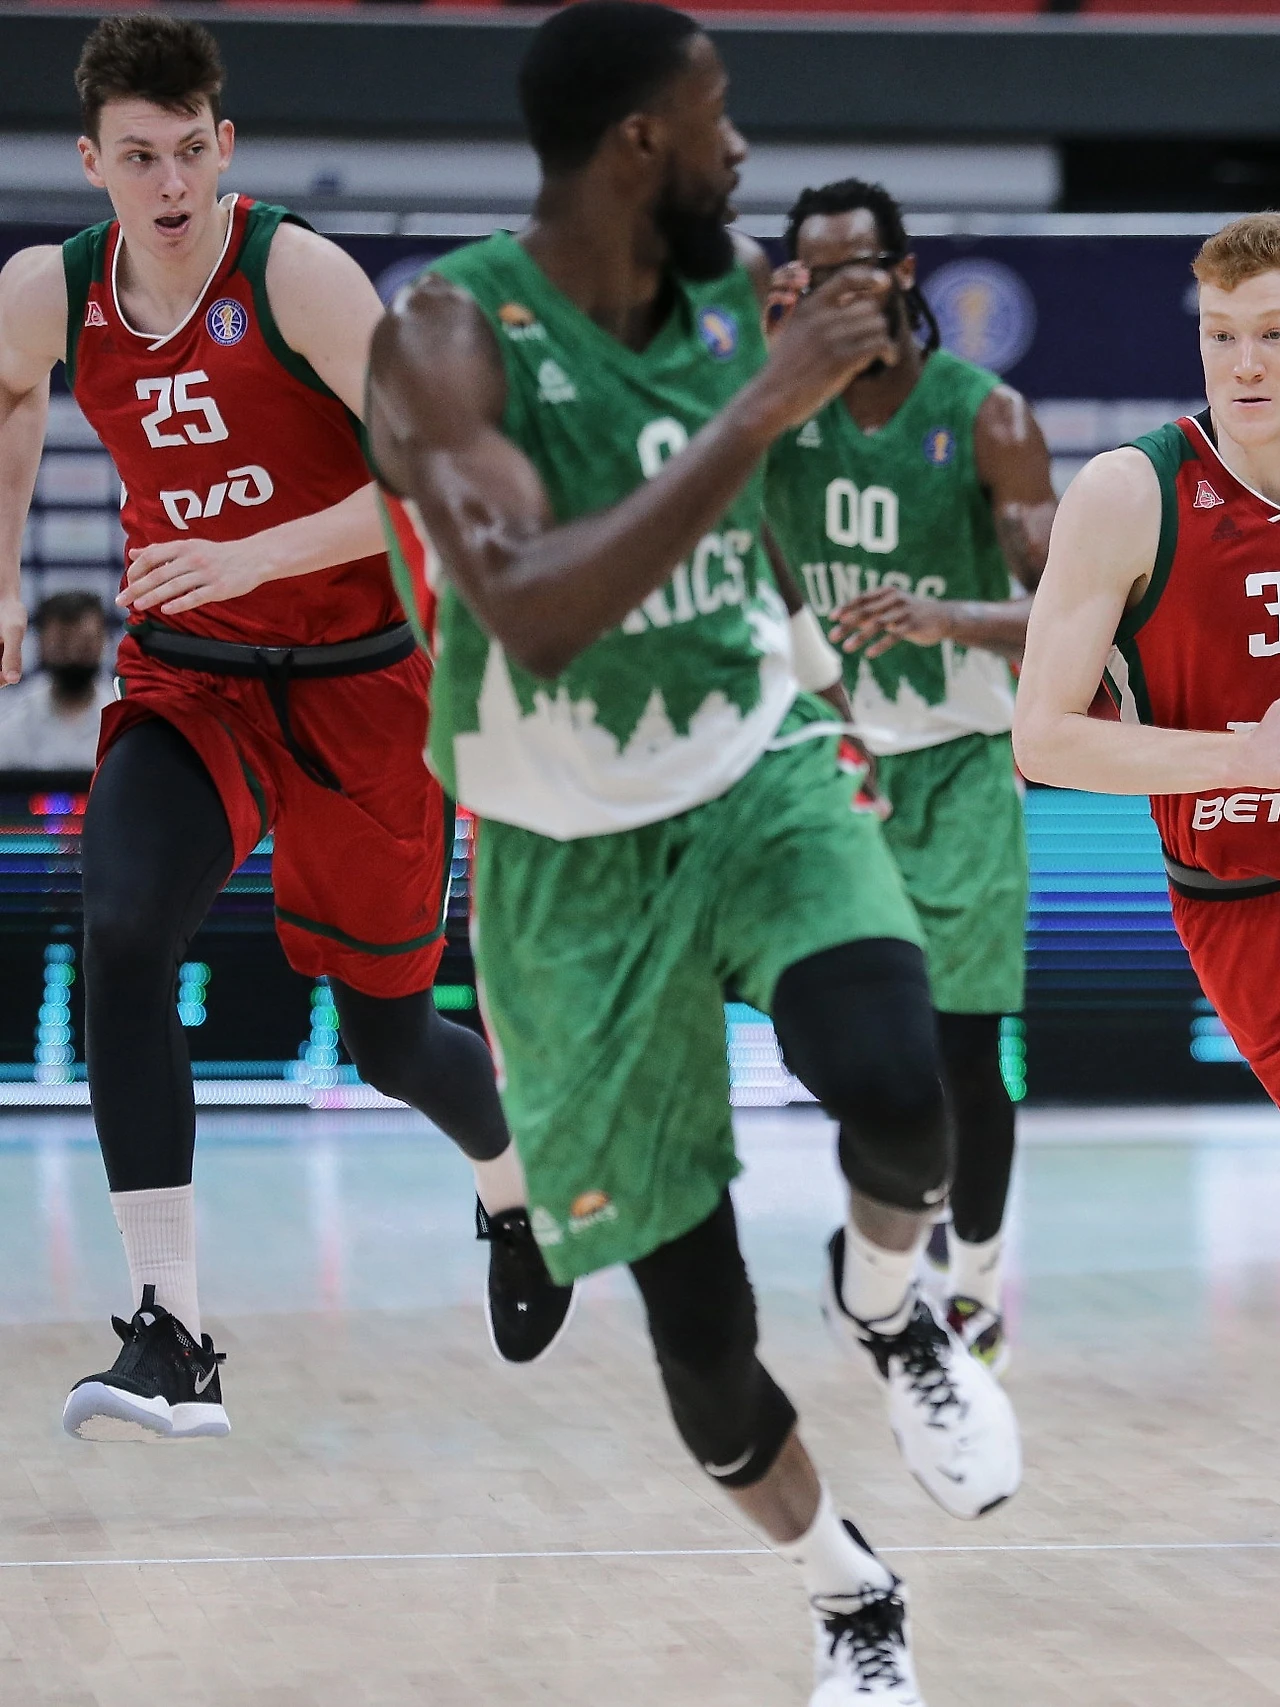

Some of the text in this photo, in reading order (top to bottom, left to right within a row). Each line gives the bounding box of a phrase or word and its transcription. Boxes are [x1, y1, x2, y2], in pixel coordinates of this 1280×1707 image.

[135, 369, 229, 449] 25
[825, 477, 899, 554] 00
[621, 529, 753, 635] ICS
